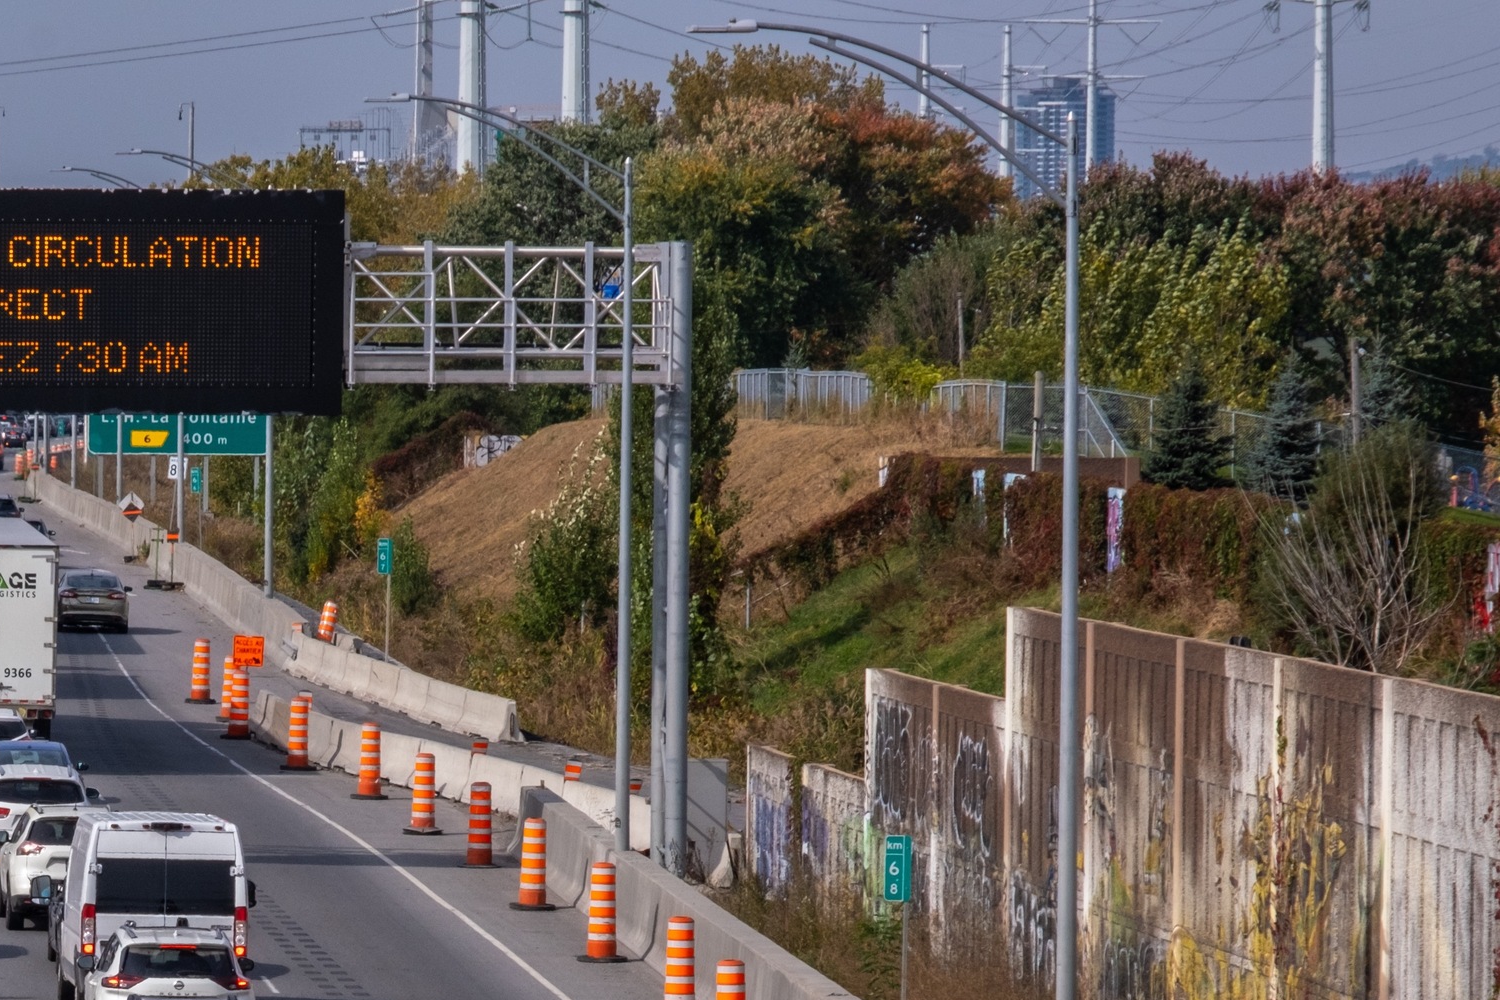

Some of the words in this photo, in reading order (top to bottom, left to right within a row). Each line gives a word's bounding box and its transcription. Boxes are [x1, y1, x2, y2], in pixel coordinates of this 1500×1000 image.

[8, 236, 260, 268] CIRCULATION
[55, 341, 127, 373] 730
[139, 342, 189, 373] AM
[183, 414, 257, 424] ontaine
[143, 434, 151, 443] 6
[183, 433, 213, 444] 400
[170, 463, 178, 476] 8
[380, 552, 386, 560] 6
[4, 668, 32, 678] 9366
[887, 841, 903, 849] km
[889, 861, 899, 876] 6
